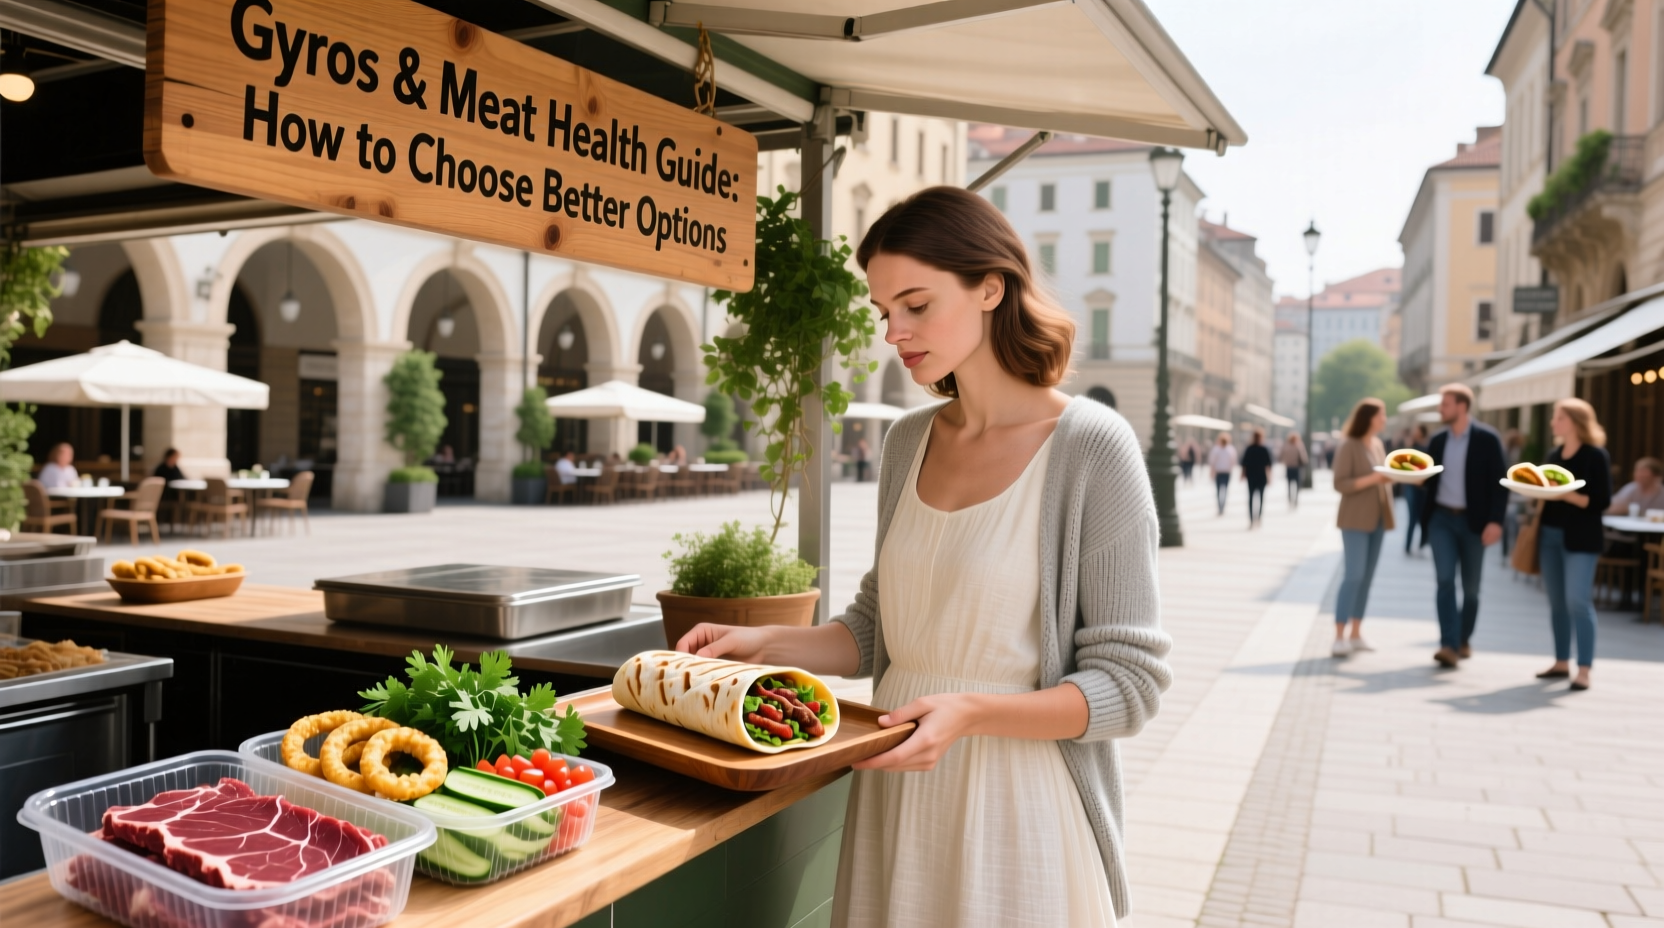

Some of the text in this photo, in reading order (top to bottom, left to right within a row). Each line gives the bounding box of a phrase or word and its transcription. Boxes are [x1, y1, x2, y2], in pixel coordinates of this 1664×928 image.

[230, 0, 739, 203] Gyros & Meat Health Guide:
[243, 84, 727, 254] How to Choose Better Options
